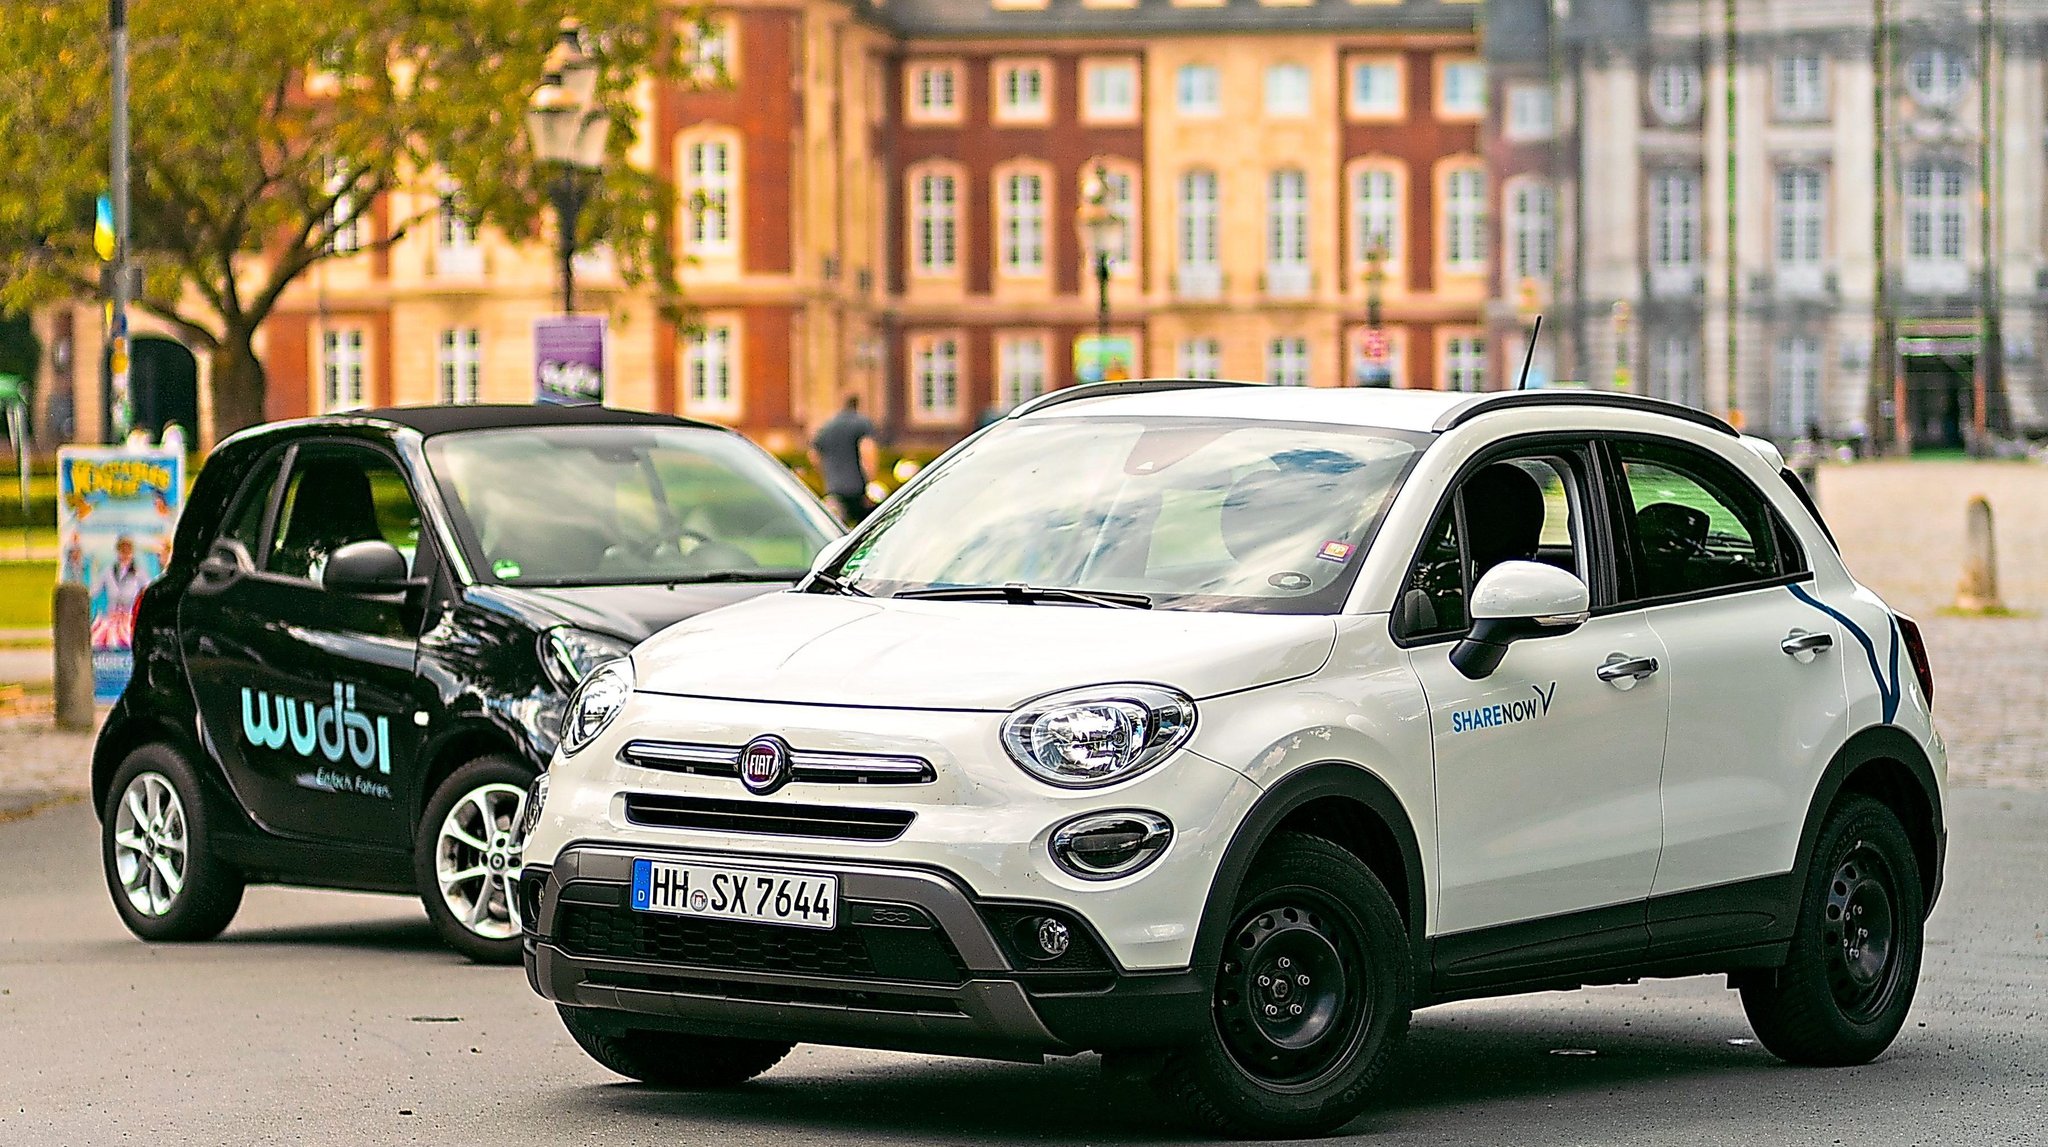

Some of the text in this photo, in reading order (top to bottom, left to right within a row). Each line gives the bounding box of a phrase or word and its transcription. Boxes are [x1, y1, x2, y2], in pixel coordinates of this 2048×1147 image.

[749, 754, 774, 776] FIAT
[638, 890, 645, 901] D
[652, 867, 830, 922] HH SX 7644
